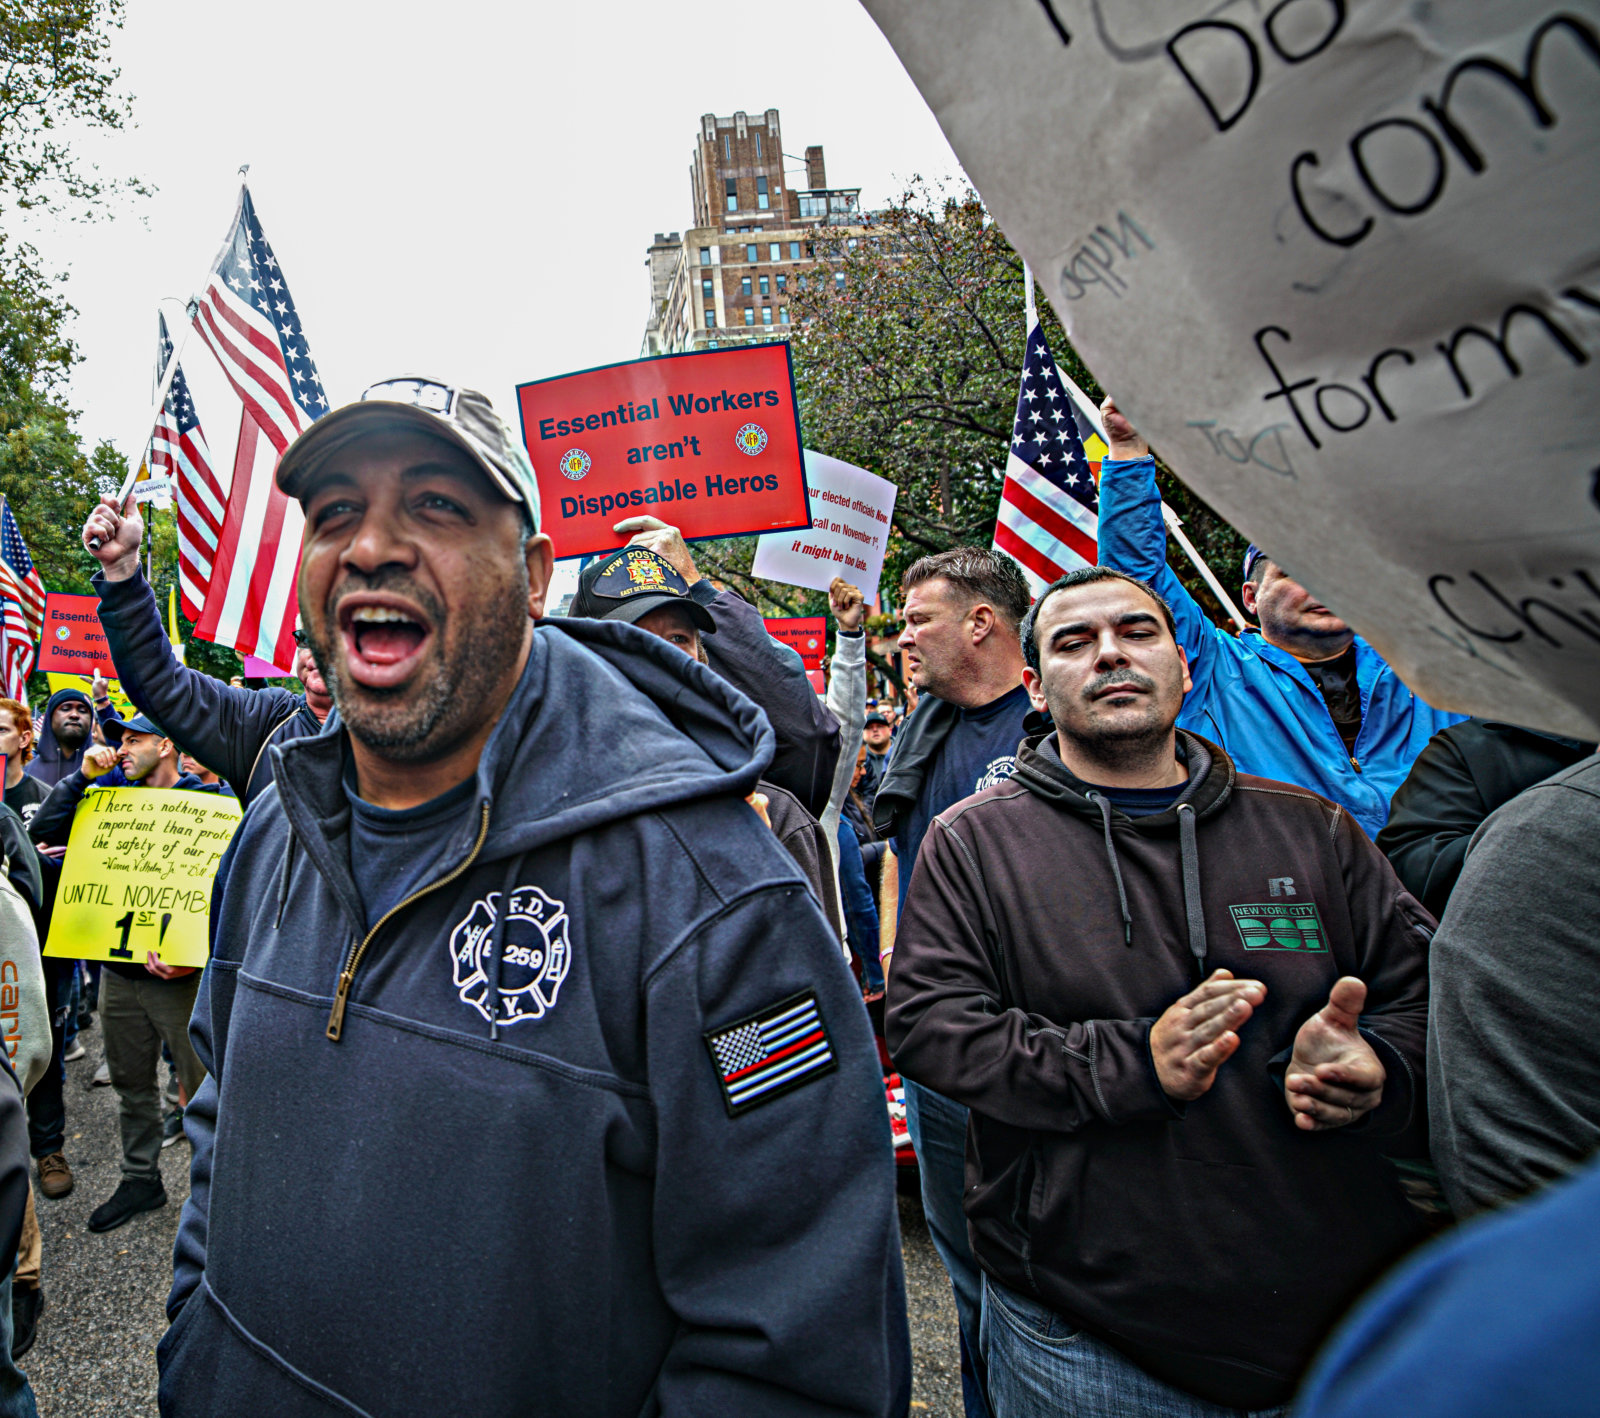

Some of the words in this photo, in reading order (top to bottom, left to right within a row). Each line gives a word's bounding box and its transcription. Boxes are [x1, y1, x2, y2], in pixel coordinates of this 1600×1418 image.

[539, 398, 659, 441] Essential
[668, 389, 780, 416] Workers
[627, 436, 701, 464] aren't
[560, 479, 698, 518] Disposable
[705, 473, 779, 497] Heros
[822, 490, 851, 508] elected
[851, 500, 875, 519] officials
[813, 518, 829, 530] call
[831, 523, 841, 532] on
[842, 524, 872, 544] November
[602, 557, 624, 577] VFW
[626, 550, 656, 560] POST
[791, 540, 801, 552] it
[802, 544, 832, 559] might
[833, 550, 844, 562] be
[845, 554, 855, 567] too
[51, 609, 101, 624] Essentia
[51, 645, 108, 661] Disposable
[140, 799, 154, 811] is
[160, 800, 207, 824] nothing
[98, 817, 156, 838] important
[163, 820, 193, 837] than
[91, 833, 109, 850] the
[115, 836, 156, 859] safety
[162, 840, 180, 859] of
[183, 846, 205, 857] our
[63, 883, 113, 906] UNTIL
[122, 884, 210, 916] NOVEMB
[1234, 906, 1259, 915] NEW
[1260, 907, 1289, 915] YORK
[1289, 906, 1314, 916] CITY
[1238, 918, 1321, 949] DOT
[502, 944, 544, 970] 259
[0, 960, 23, 1071] carh
